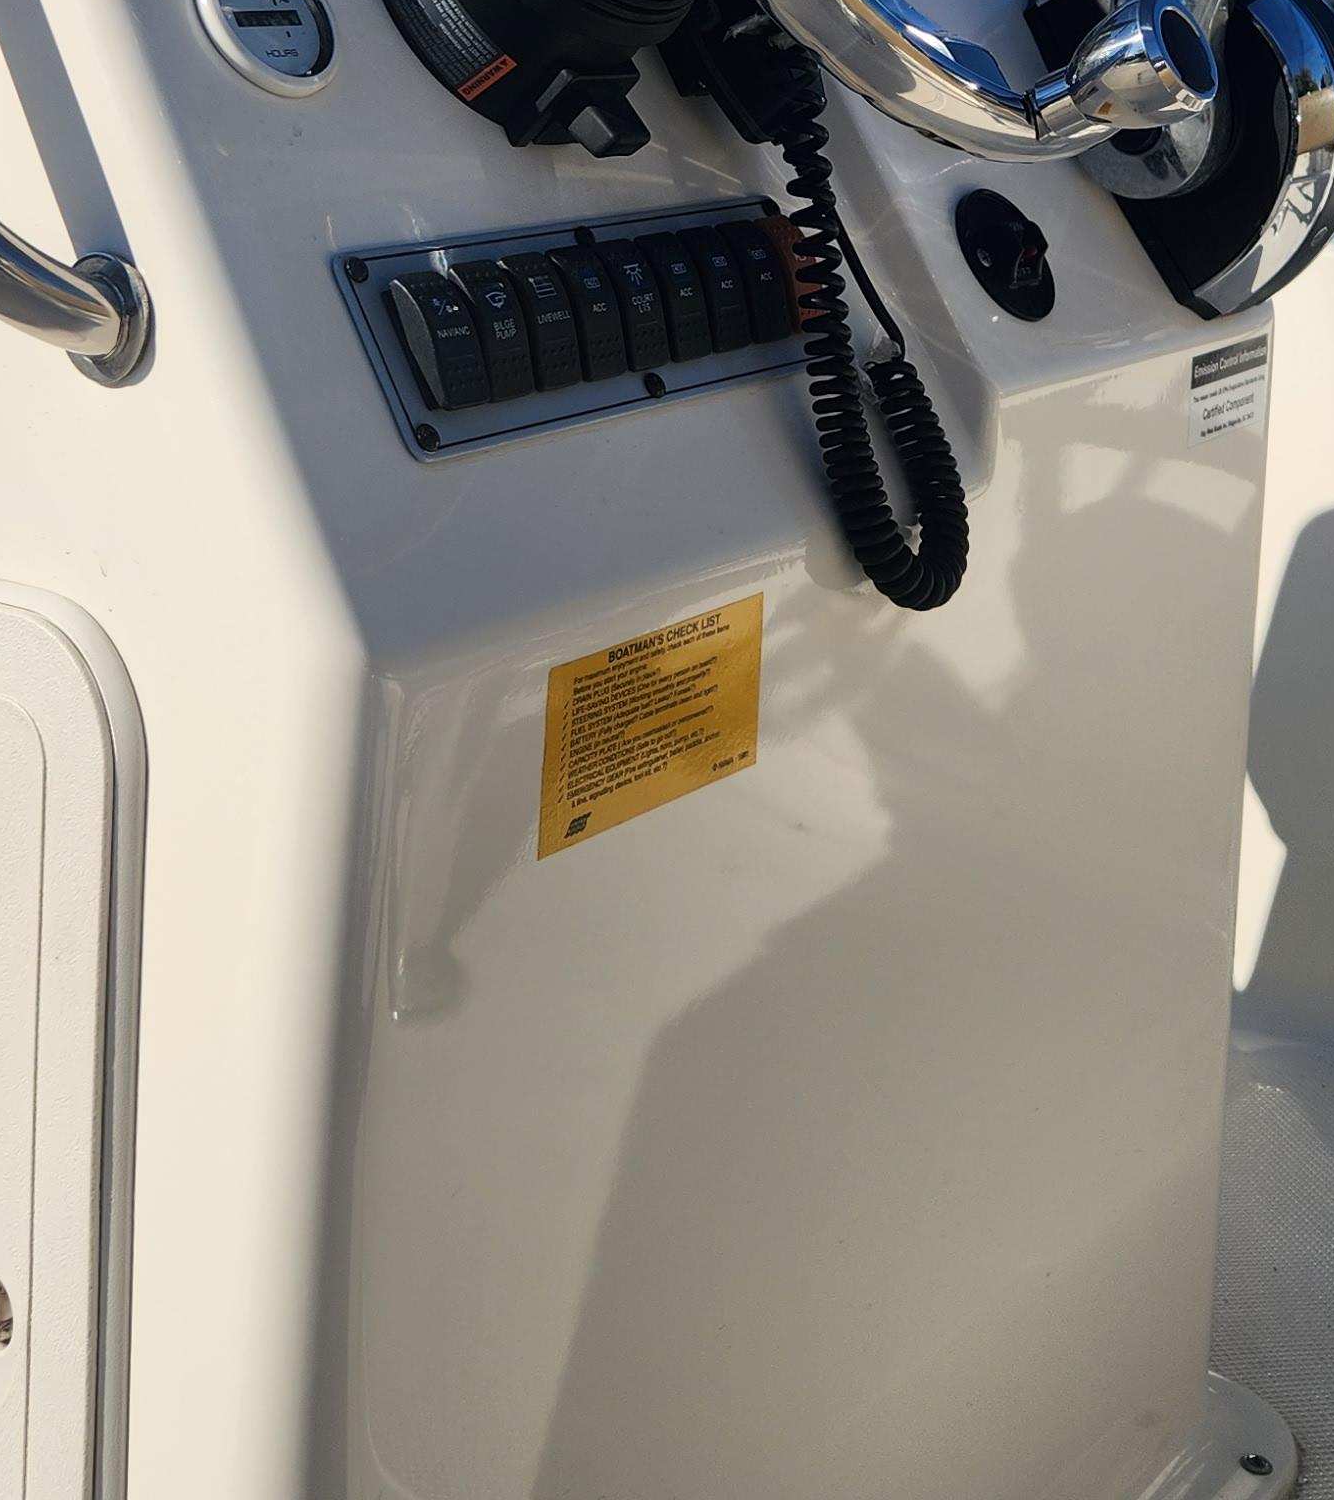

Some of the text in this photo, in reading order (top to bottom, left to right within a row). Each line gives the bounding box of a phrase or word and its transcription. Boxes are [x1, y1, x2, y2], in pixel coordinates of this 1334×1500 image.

[266, 49, 298, 58] HOURS
[461, 63, 502, 96] WARNING
[680, 287, 693, 297] ACC
[593, 303, 607, 312] ACC
[537, 310, 571, 324] LIVEWELL
[493, 318, 515, 332] BILGE
[496, 328, 517, 340] PUMP
[1194, 361, 1218, 378] Emission
[608, 612, 721, 663] BOATMAN'S CHECK LIST
